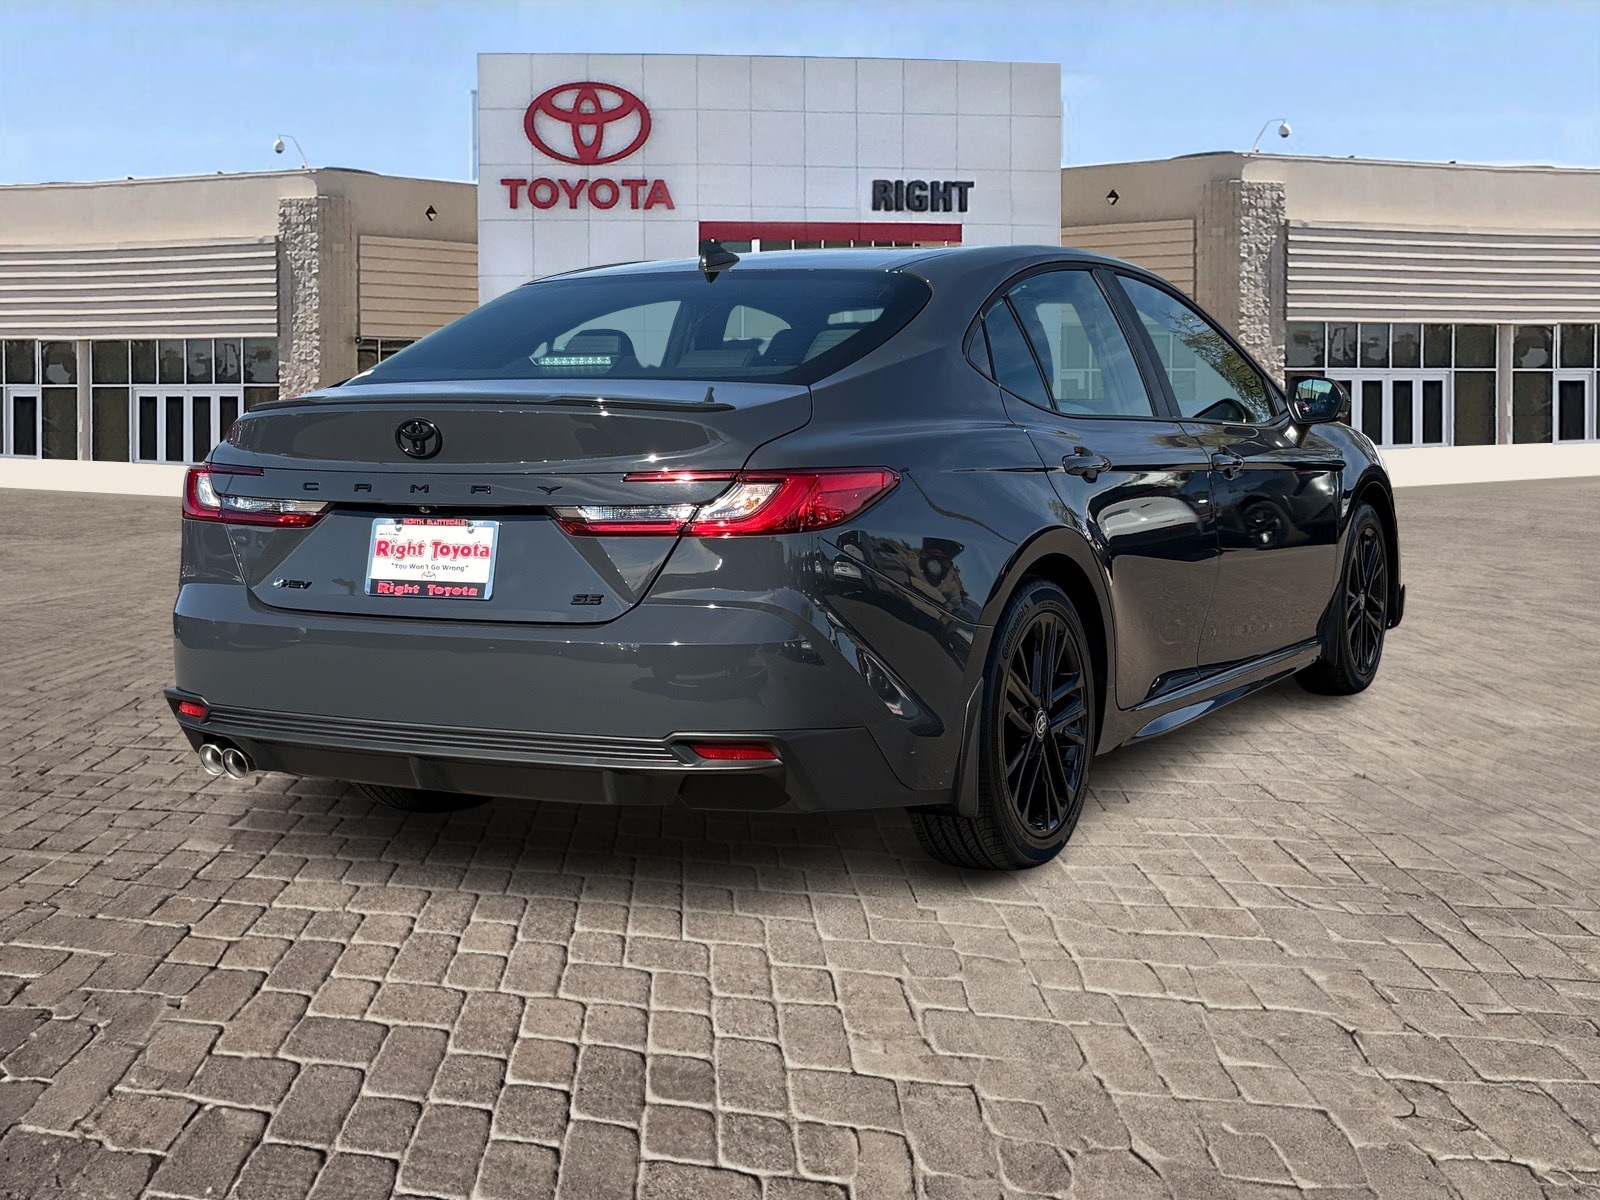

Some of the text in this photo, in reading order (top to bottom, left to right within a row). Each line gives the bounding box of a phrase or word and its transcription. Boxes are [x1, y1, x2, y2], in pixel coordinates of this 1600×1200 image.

[501, 178, 675, 210] TOYOTA
[872, 180, 975, 213] RIGHT
[303, 482, 563, 496] CAMRY
[375, 540, 490, 560] Right Toyota
[410, 563, 430, 571] Won't
[377, 581, 478, 596] Right Toyota
[570, 593, 605, 606] SE
[1002, 606, 1026, 660] Continental
